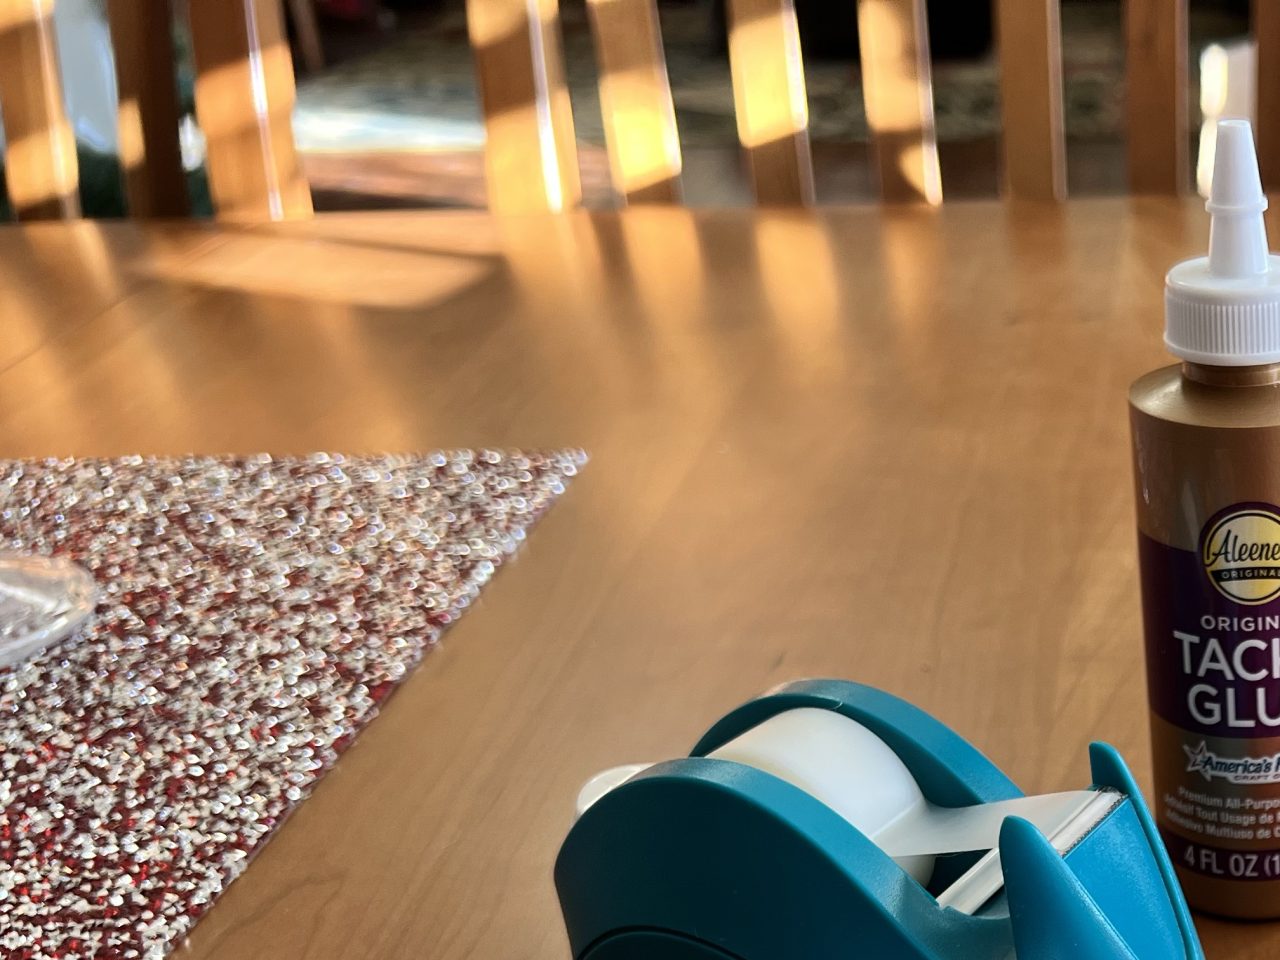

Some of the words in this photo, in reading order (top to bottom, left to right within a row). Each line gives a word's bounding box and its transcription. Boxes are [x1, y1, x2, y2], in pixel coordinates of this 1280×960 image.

[1202, 755, 1271, 775] America's
[1220, 811, 1256, 827] Usage
[1259, 812, 1274, 825] de
[1256, 827, 1271, 839] de
[1184, 845, 1195, 866] 4
[1200, 848, 1225, 875] FL
[1229, 853, 1259, 877] OZ
